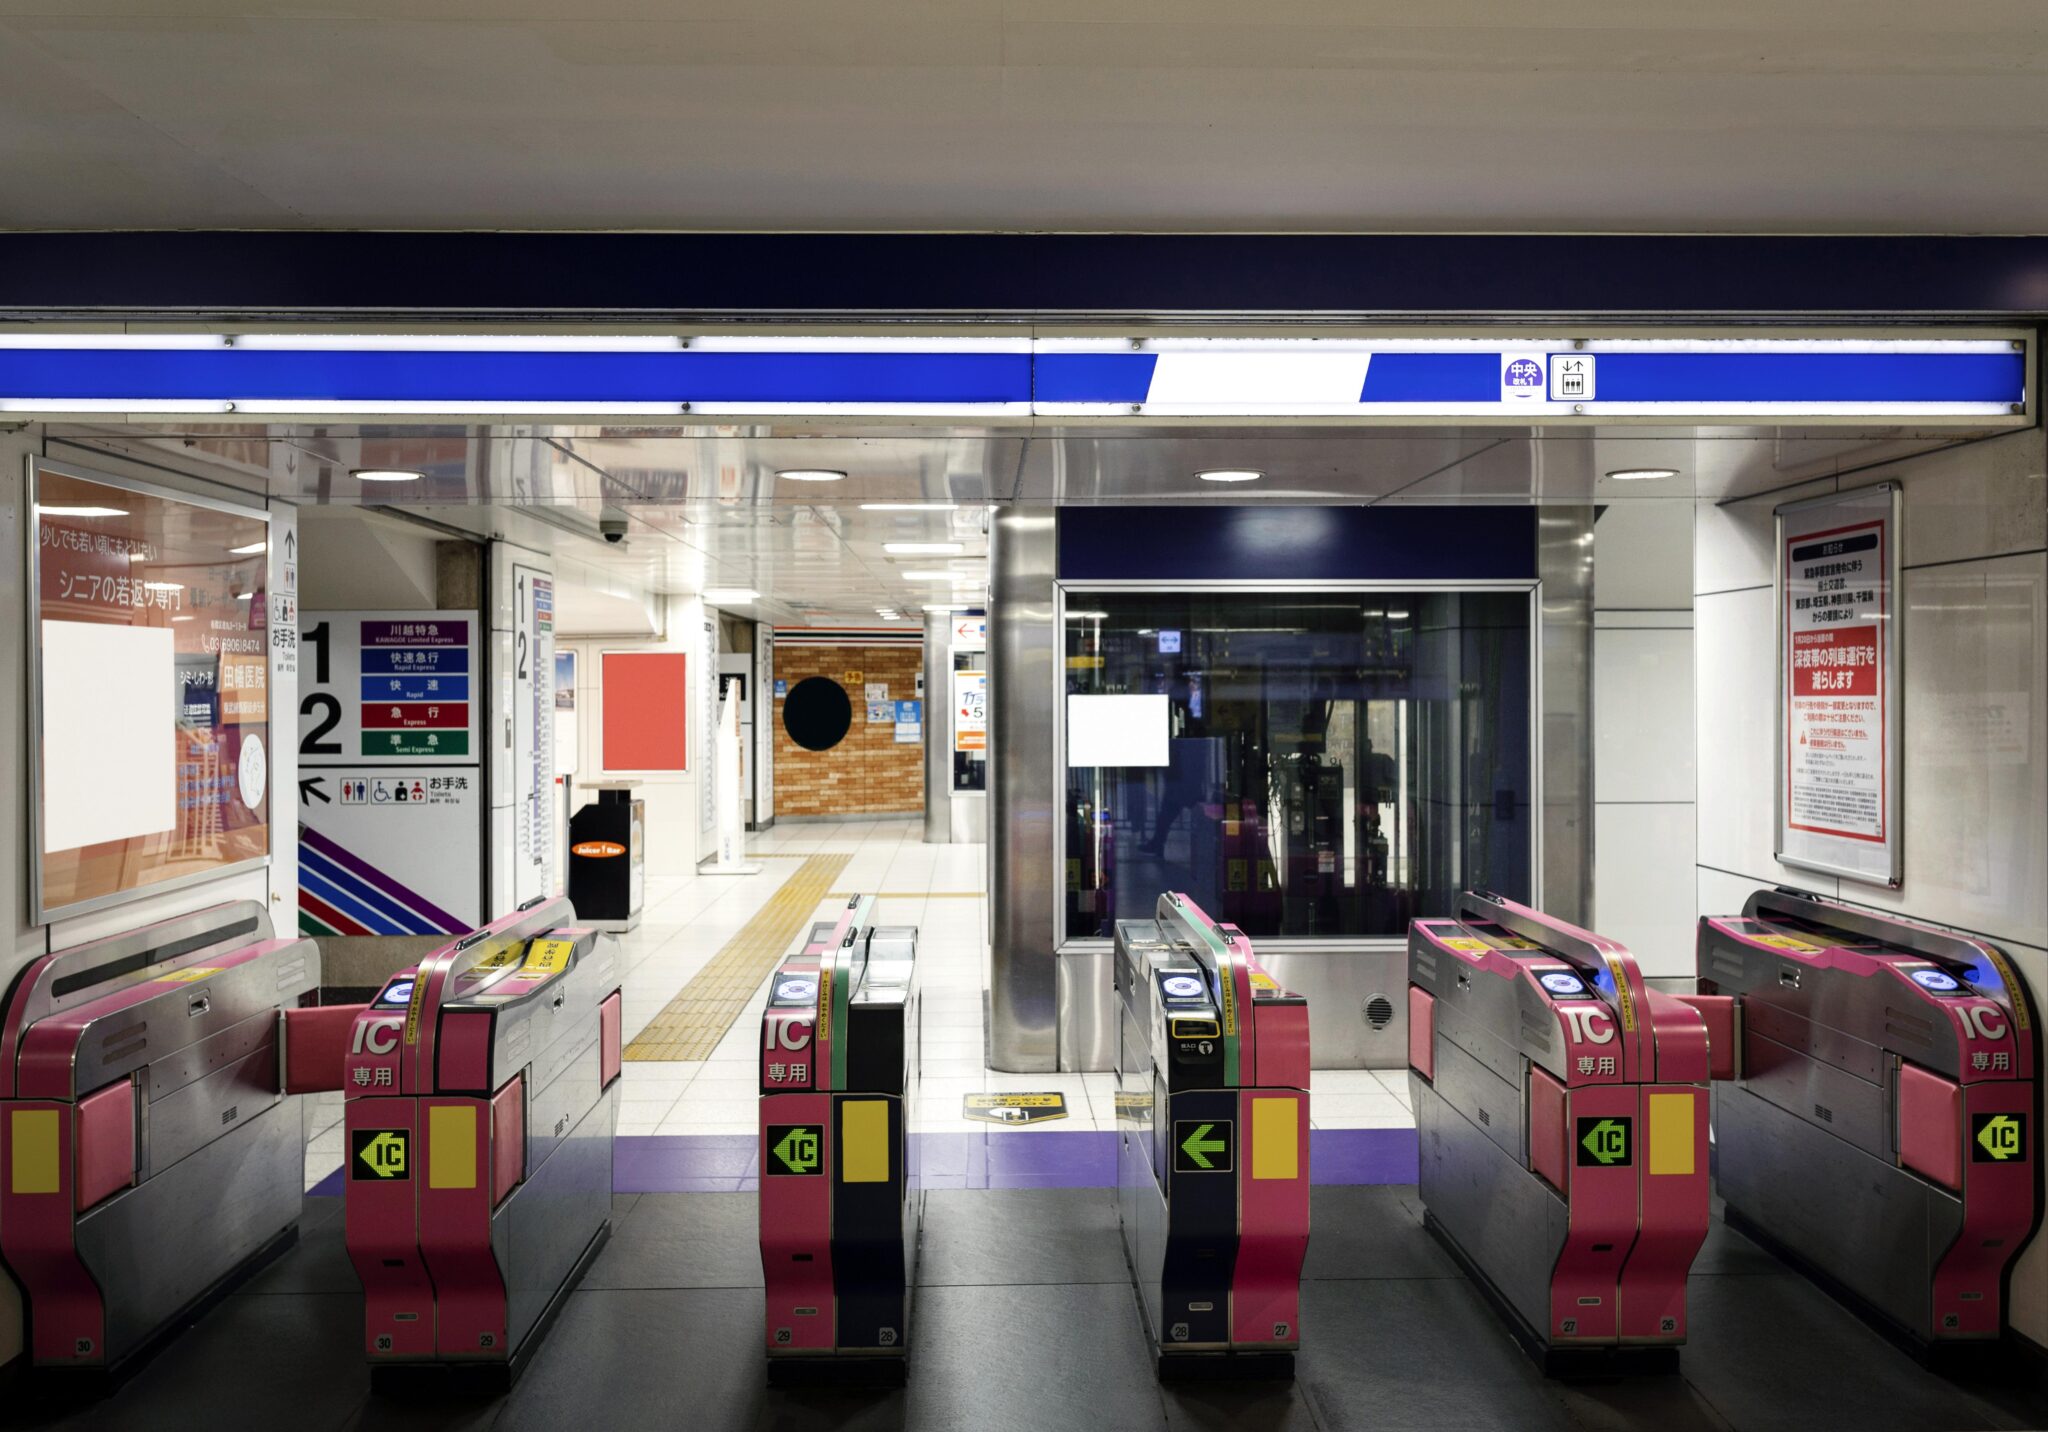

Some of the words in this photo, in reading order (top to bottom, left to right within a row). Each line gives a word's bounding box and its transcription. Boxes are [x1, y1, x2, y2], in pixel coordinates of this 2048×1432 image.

[1511, 362, 1537, 377] 中央
[41, 524, 158, 561] 少しでも若い頃にもどりたい
[60, 570, 181, 611] シニアの若返り専門
[272, 628, 296, 649] お手洗
[390, 624, 439, 636] 川越特急
[431, 637, 454, 645] Express
[302, 621, 329, 683] 1
[390, 652, 440, 664] 快速急行
[517, 630, 527, 680] 2
[1794, 645, 1875, 669] 深夜帯の列車運行を
[223, 664, 266, 689] 田幡医院
[390, 679, 439, 691] 快速
[1811, 670, 1855, 690] 減らします
[406, 691, 424, 699] Rapid
[391, 706, 439, 719] 急行
[299, 692, 342, 754] 2
[403, 719, 427, 727] Express
[390, 734, 439, 747] 準急
[411, 746, 435, 754] Express
[429, 777, 468, 790] お手洗
[578, 846, 601, 855] Juicer
[606, 846, 622, 854] Bar
[1565, 1008, 1615, 1044] IC
[1955, 1005, 2006, 1041] IC
[352, 1020, 401, 1055] IC
[766, 1017, 813, 1051] IC
[1576, 1056, 1616, 1076] 専用
[1971, 1051, 2010, 1072] 専用
[352, 1066, 394, 1087] 専用
[768, 1062, 807, 1083] 専用
[1597, 1130, 1622, 1153] IC
[1991, 1125, 2016, 1149] IC
[376, 1143, 401, 1166] IC
[789, 1139, 814, 1162] IC
[1174, 1326, 1188, 1337] 28
[1274, 1325, 1288, 1336] 27
[1562, 1321, 1576, 1333] 27
[1661, 1319, 1675, 1331] 26
[377, 1337, 391, 1350] 30
[480, 1335, 493, 1347] 29
[777, 1330, 791, 1342] 29
[880, 1330, 894, 1342] 28
